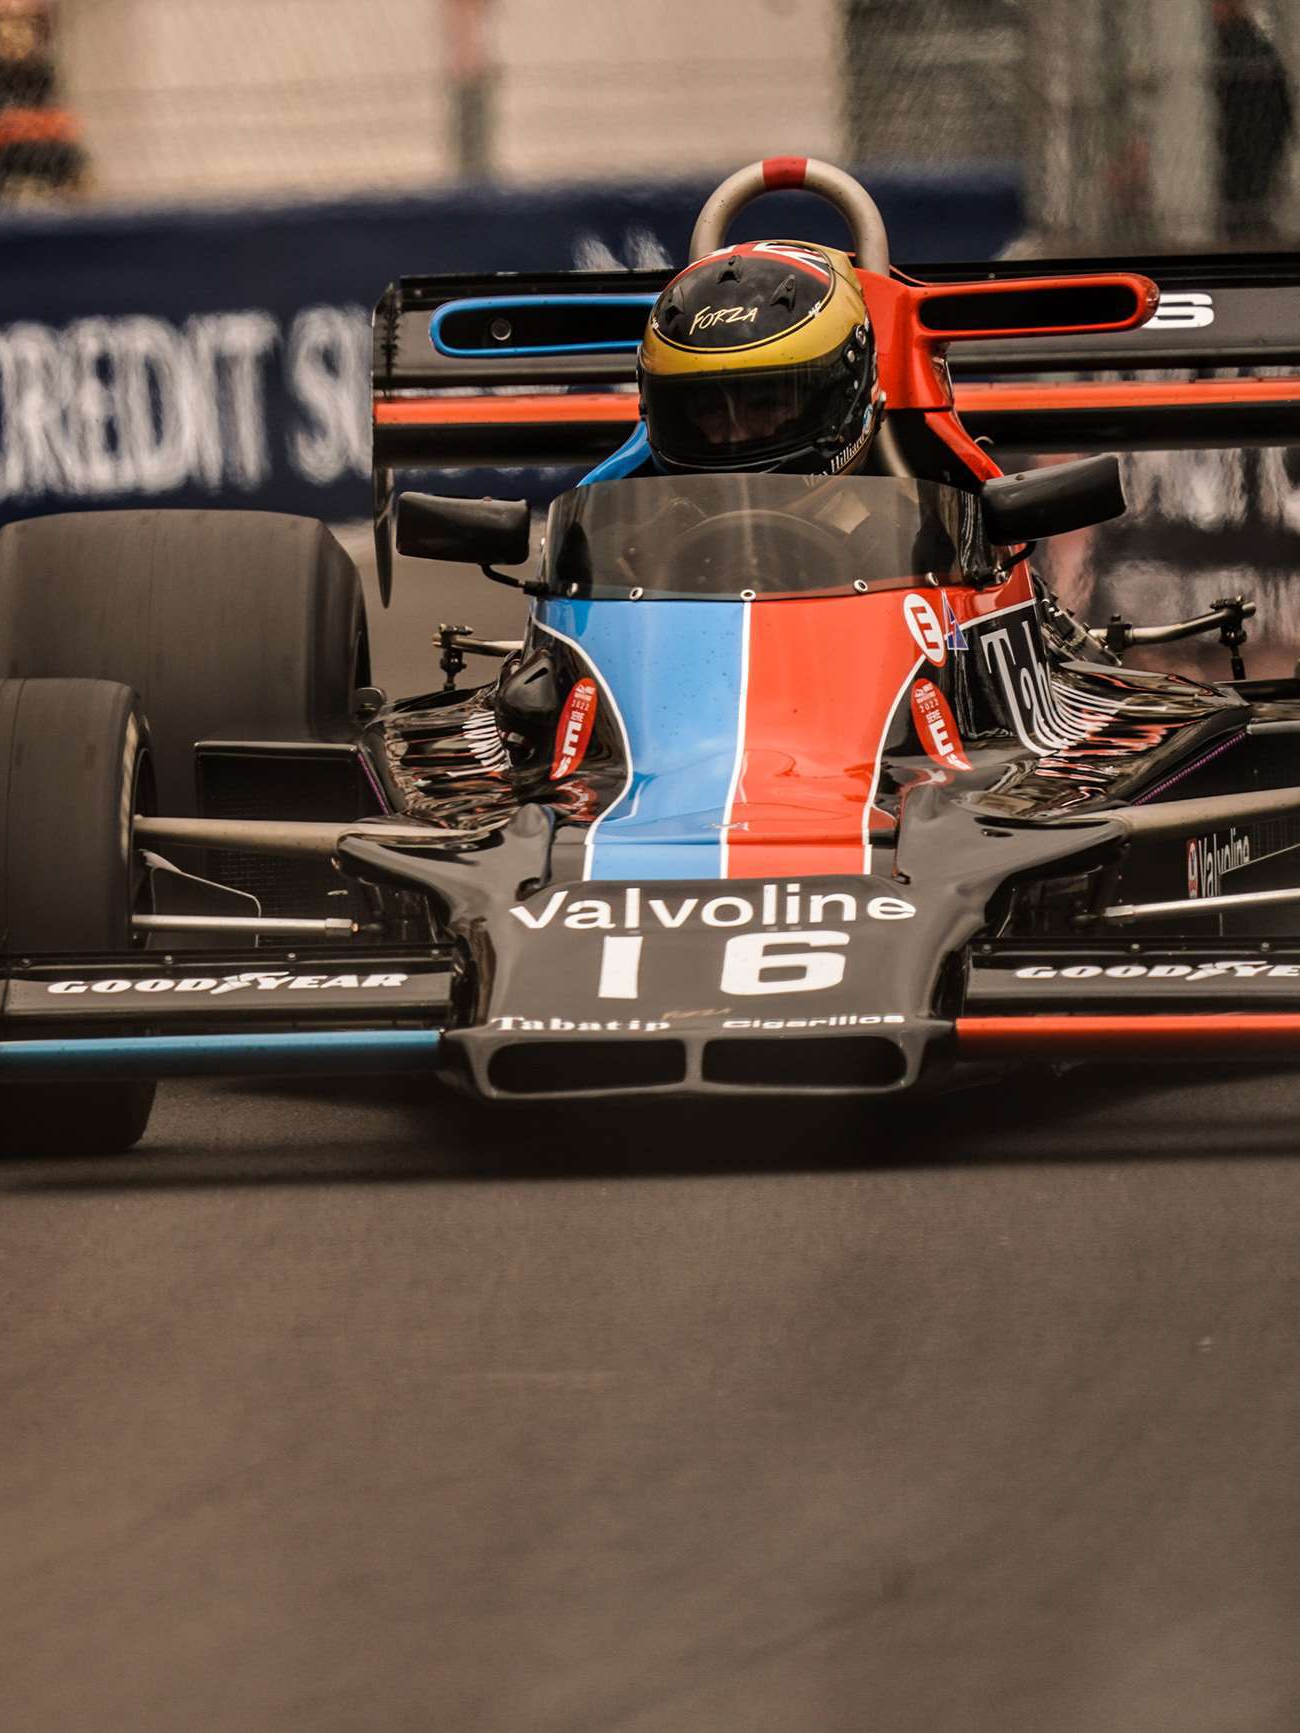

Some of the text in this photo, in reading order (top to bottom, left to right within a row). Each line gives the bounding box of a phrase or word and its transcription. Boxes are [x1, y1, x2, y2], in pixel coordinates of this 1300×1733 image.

[689, 306, 758, 336] FORZA
[919, 699, 940, 713] 2022
[928, 719, 954, 757] E
[1198, 827, 1250, 897] Valvoline
[509, 884, 917, 929] Valvoline
[598, 931, 851, 999] 16
[490, 1015, 906, 1032] Tabatip Cigarillos
